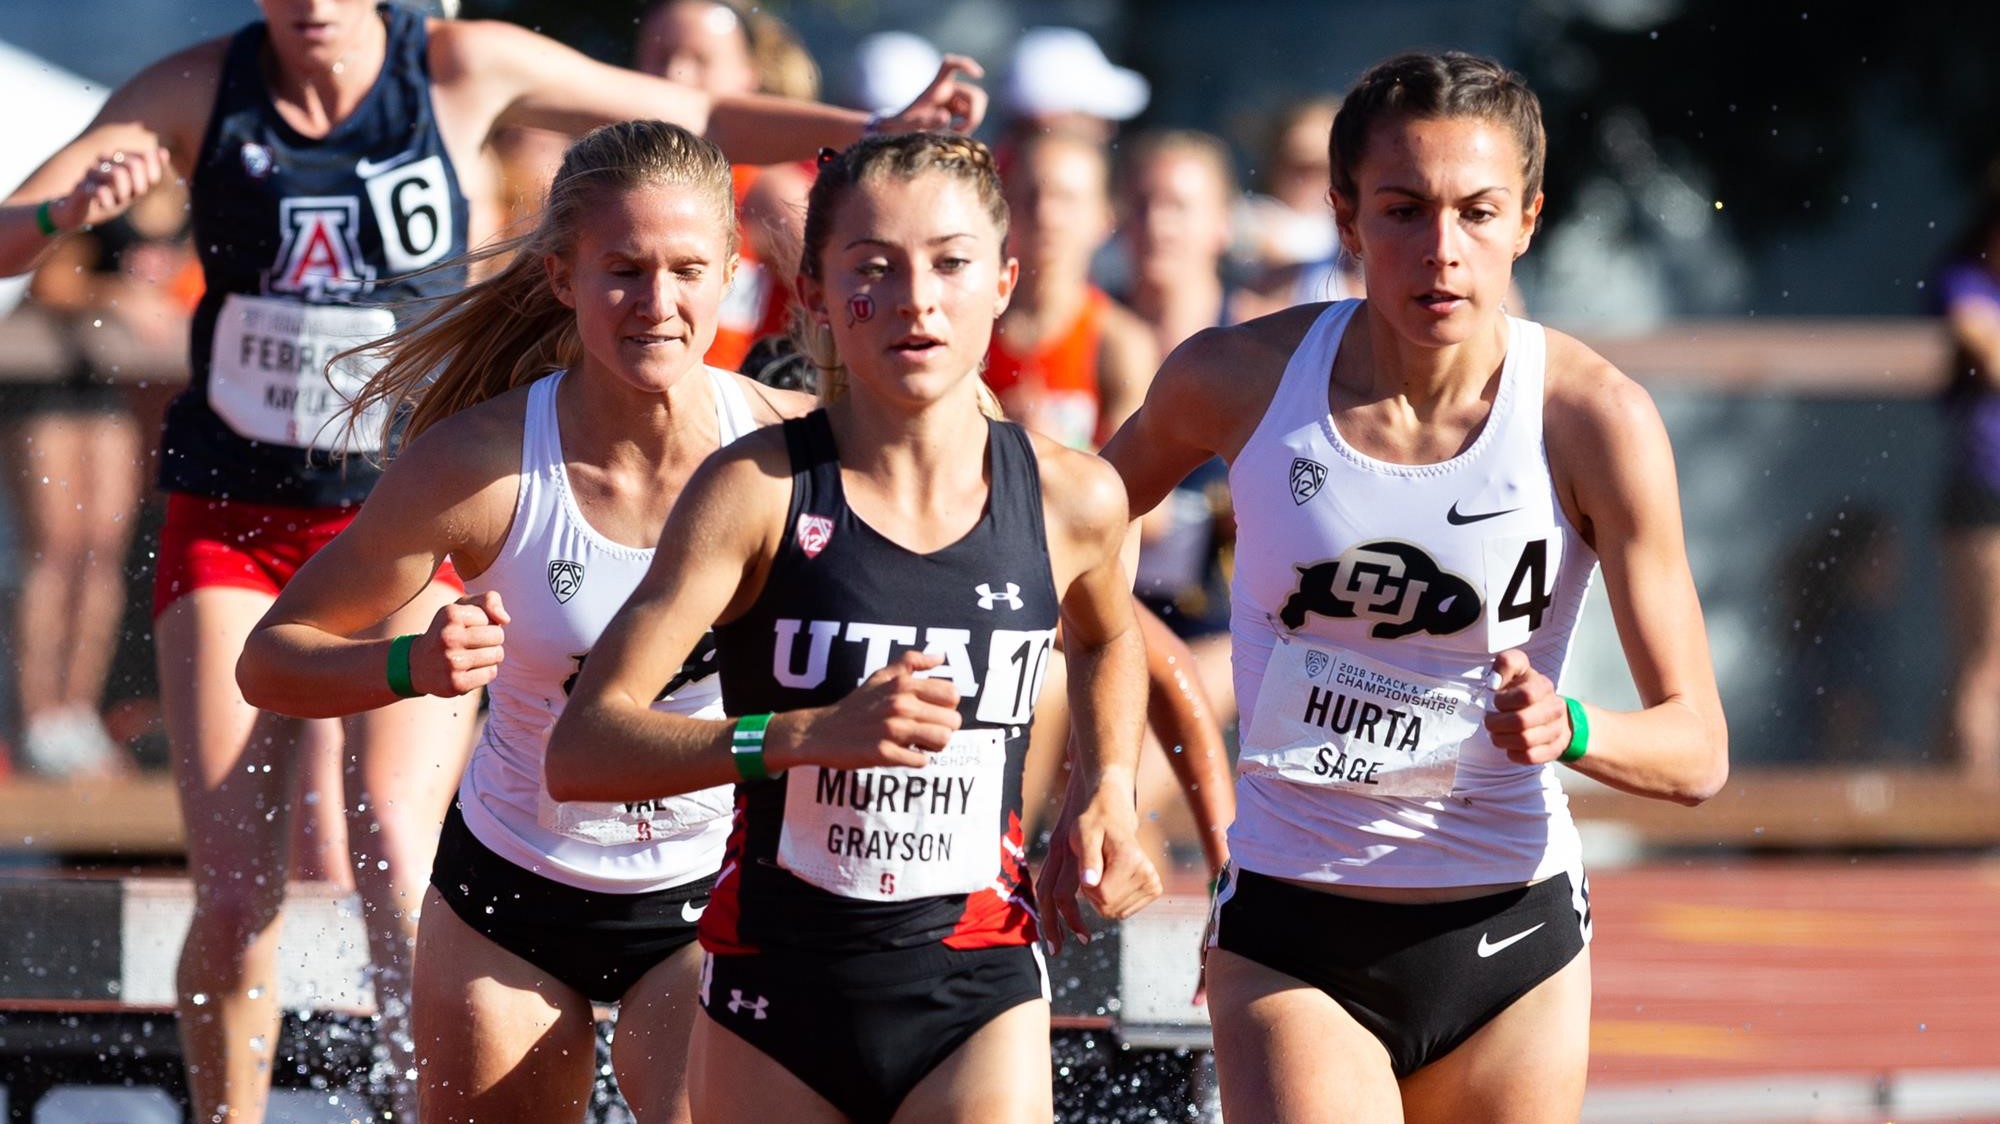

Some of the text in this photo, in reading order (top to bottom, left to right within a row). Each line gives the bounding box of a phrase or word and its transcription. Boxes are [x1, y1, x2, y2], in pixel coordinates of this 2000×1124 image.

[389, 176, 438, 256] 6
[261, 196, 377, 300] A
[1292, 460, 1325, 490] PAC
[1295, 478, 1313, 497] 12
[804, 534, 823, 552] 12
[550, 562, 582, 587] PAC
[555, 578, 573, 595] 12
[1497, 538, 1551, 632] 4
[773, 618, 980, 698] UTA
[1336, 672, 1456, 715] CHAMPIONSHIPS
[1339, 662, 1459, 705] 2018 TRACK & FIELD
[1303, 685, 1422, 752] HURTA
[1313, 747, 1384, 785] SAGE
[815, 767, 975, 815] MURPHY
[827, 824, 952, 862] GRAYSON
[879, 872, 895, 895] S
